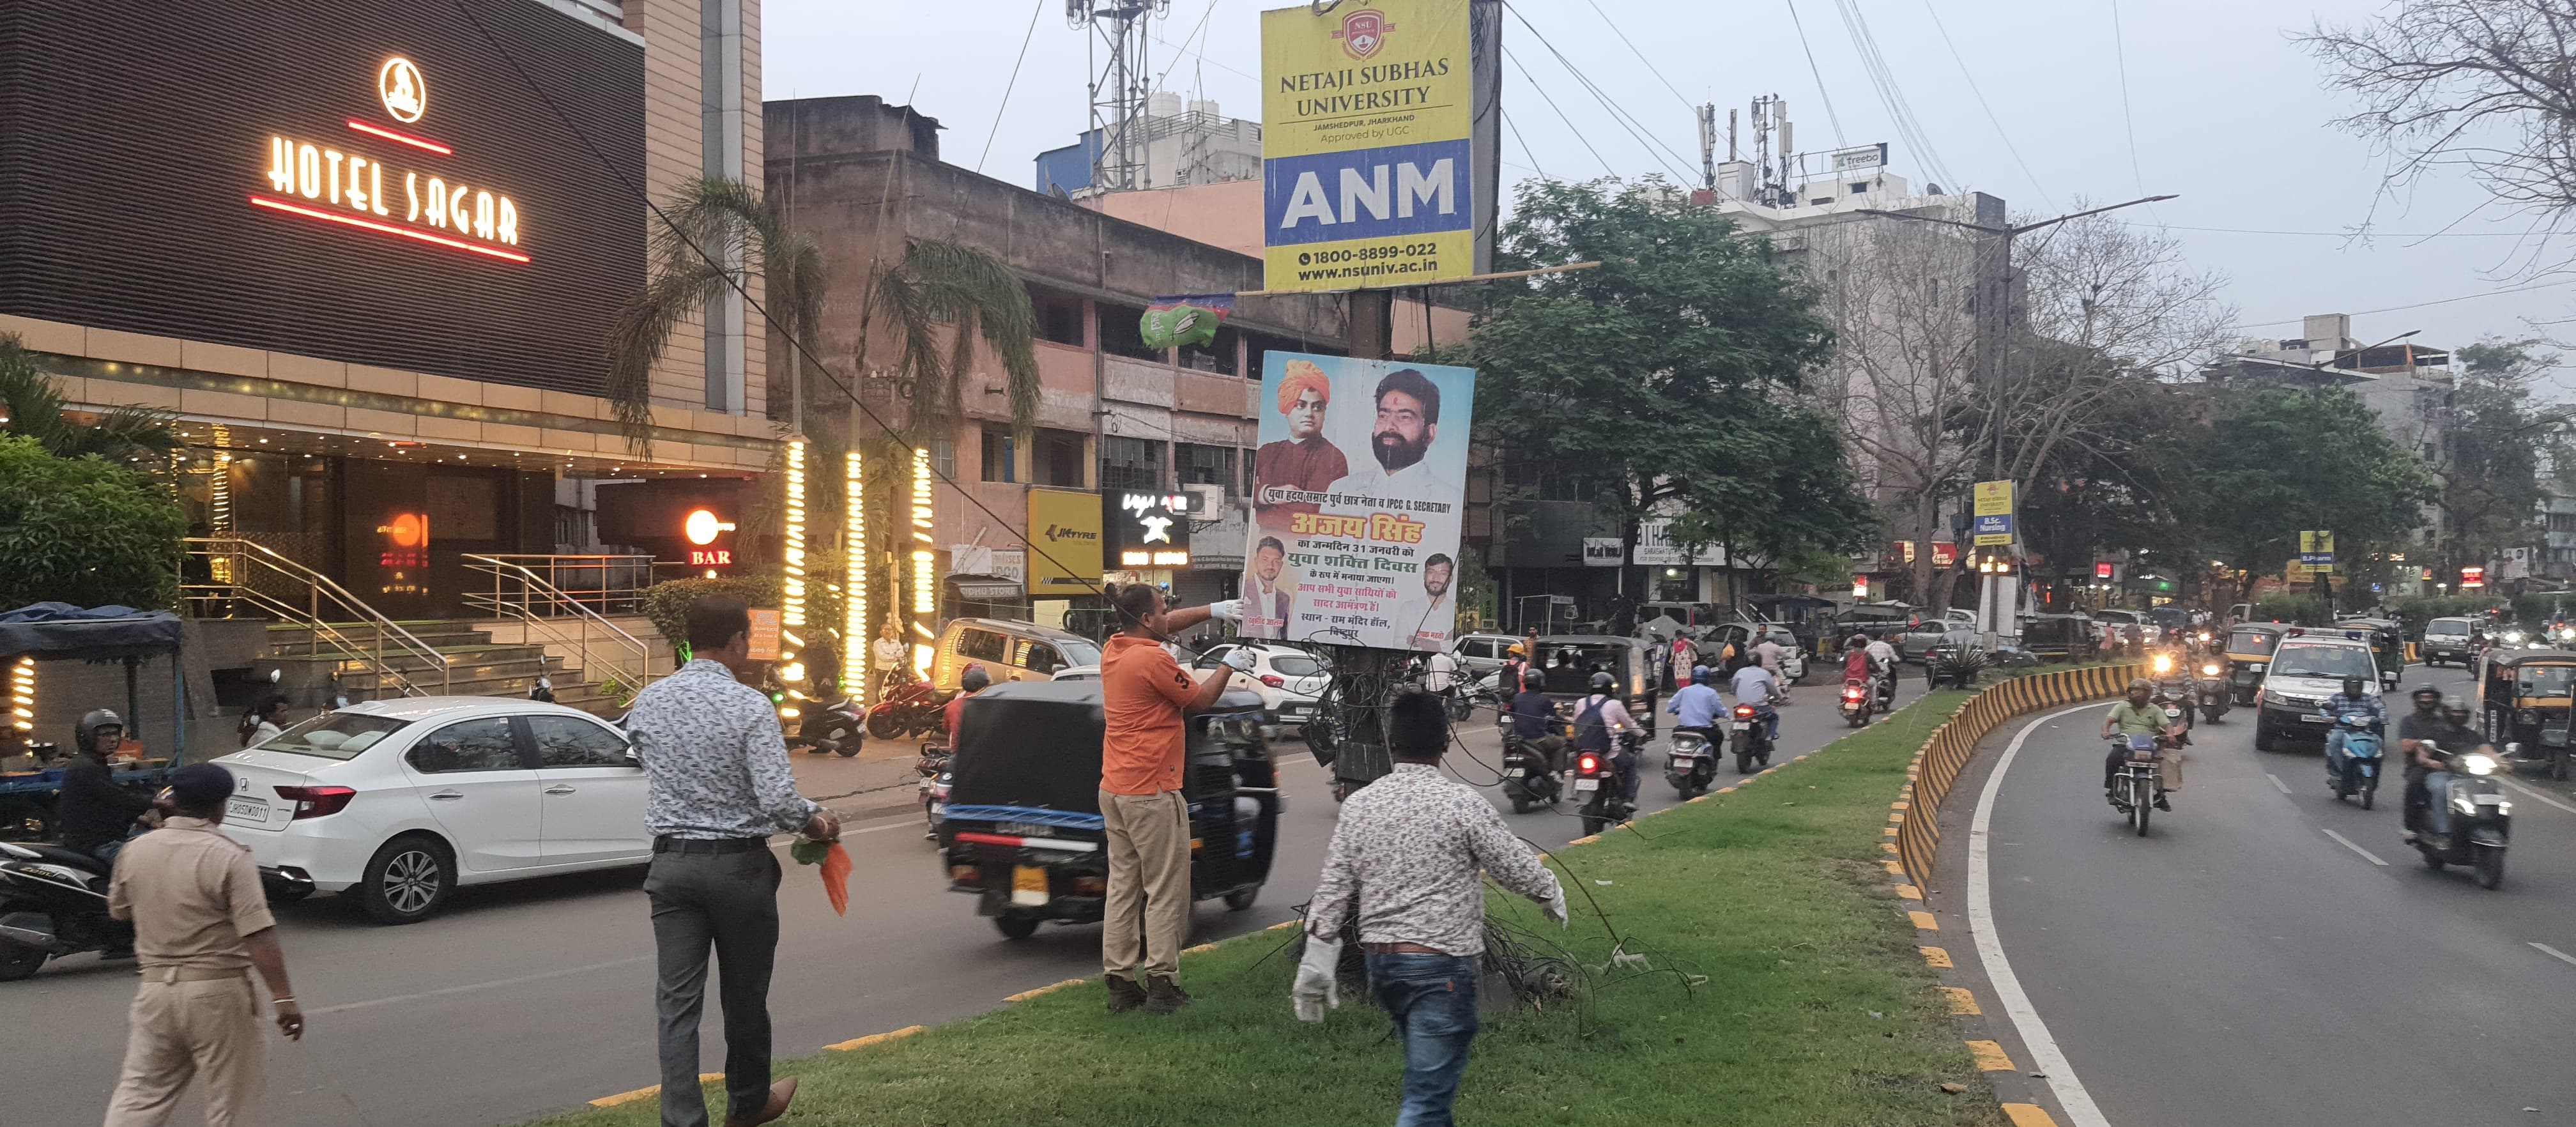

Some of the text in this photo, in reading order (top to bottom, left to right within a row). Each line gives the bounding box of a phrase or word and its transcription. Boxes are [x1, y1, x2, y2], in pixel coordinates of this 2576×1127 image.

[1280, 57, 1448, 93] NETAJI SUBHAS
[1297, 86, 1430, 117] UNIVERSITY
[1314, 114, 1415, 132] JAMSHEDPUR, JHARKHAND
[1320, 126, 1410, 144] Approved by UGC
[1847, 154, 1878, 164] treebo
[268, 137, 518, 245] HOTEL SAGAR
[1280, 158, 1455, 229] ANM
[1314, 243, 1437, 264] 1800-8899-022
[1298, 259, 1438, 280] www.nsuniv.ac.in
[1269, 489, 1284, 502] युवा
[1361, 494, 1377, 507] नेता
[1379, 498, 1385, 508] व
[1386, 498, 1403, 509] JPCC
[1406, 500, 1412, 510] G.
[1414, 501, 1451, 514] SECRETARY
[1291, 512, 1426, 544] अजय सिंह
[1298, 540, 1414, 557] का जन्मदिन 31 जनवरी को
[691, 551, 732, 565] BAR
[1288, 553, 1418, 573] युवा शक्ति दिवस
[1310, 569, 1317, 578] के
[1341, 573, 1365, 582] मनाया
[990, 586, 1016, 595] STORE
[1298, 583, 1315, 592] आप
[1318, 583, 1334, 594] सभी
[1337, 586, 1352, 597] युवा
[1386, 588, 1397, 599] को
[1314, 599, 1334, 608] सादर
[1301, 613, 1322, 622] स्थान
[1331, 615, 1346, 624] राम
[1348, 615, 1368, 625] मंदिर
[1175, 672, 1189, 689] 3
